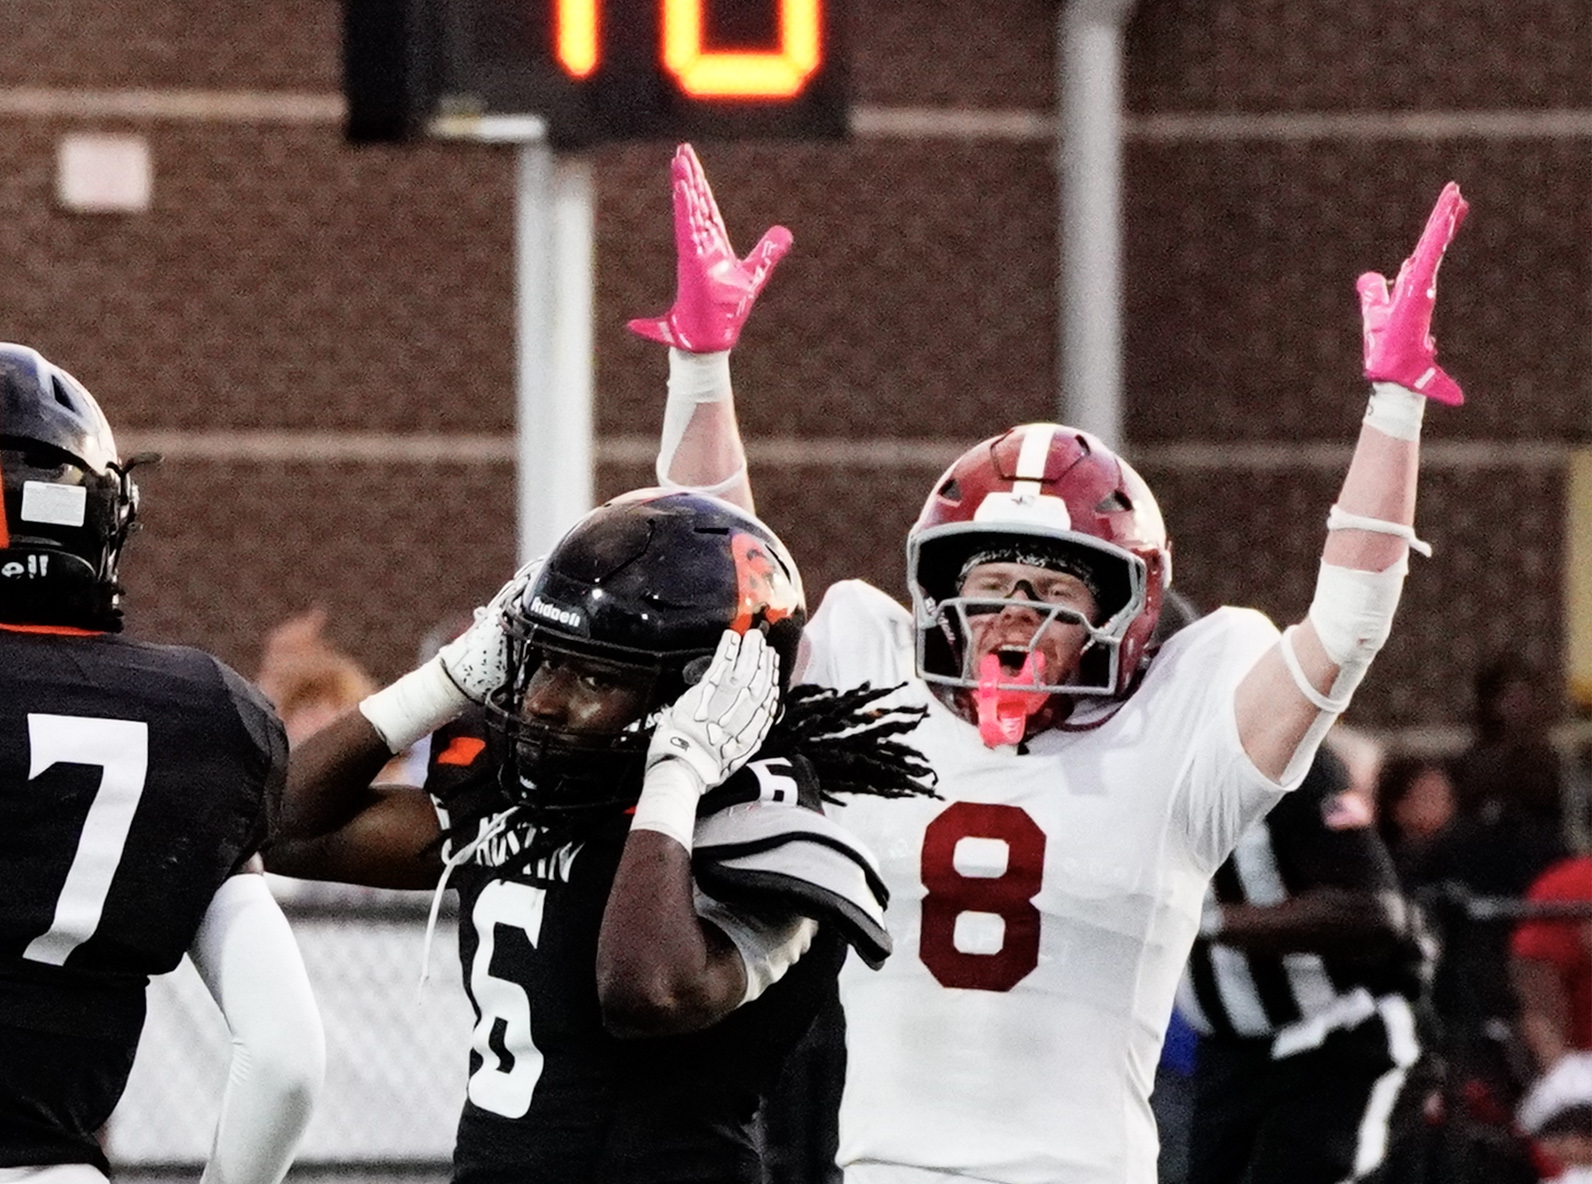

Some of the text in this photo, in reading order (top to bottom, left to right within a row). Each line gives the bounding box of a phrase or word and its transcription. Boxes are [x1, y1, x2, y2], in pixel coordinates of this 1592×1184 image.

[22, 712, 149, 966] 7
[919, 801, 1047, 993] 8
[468, 878, 547, 1119] 6
